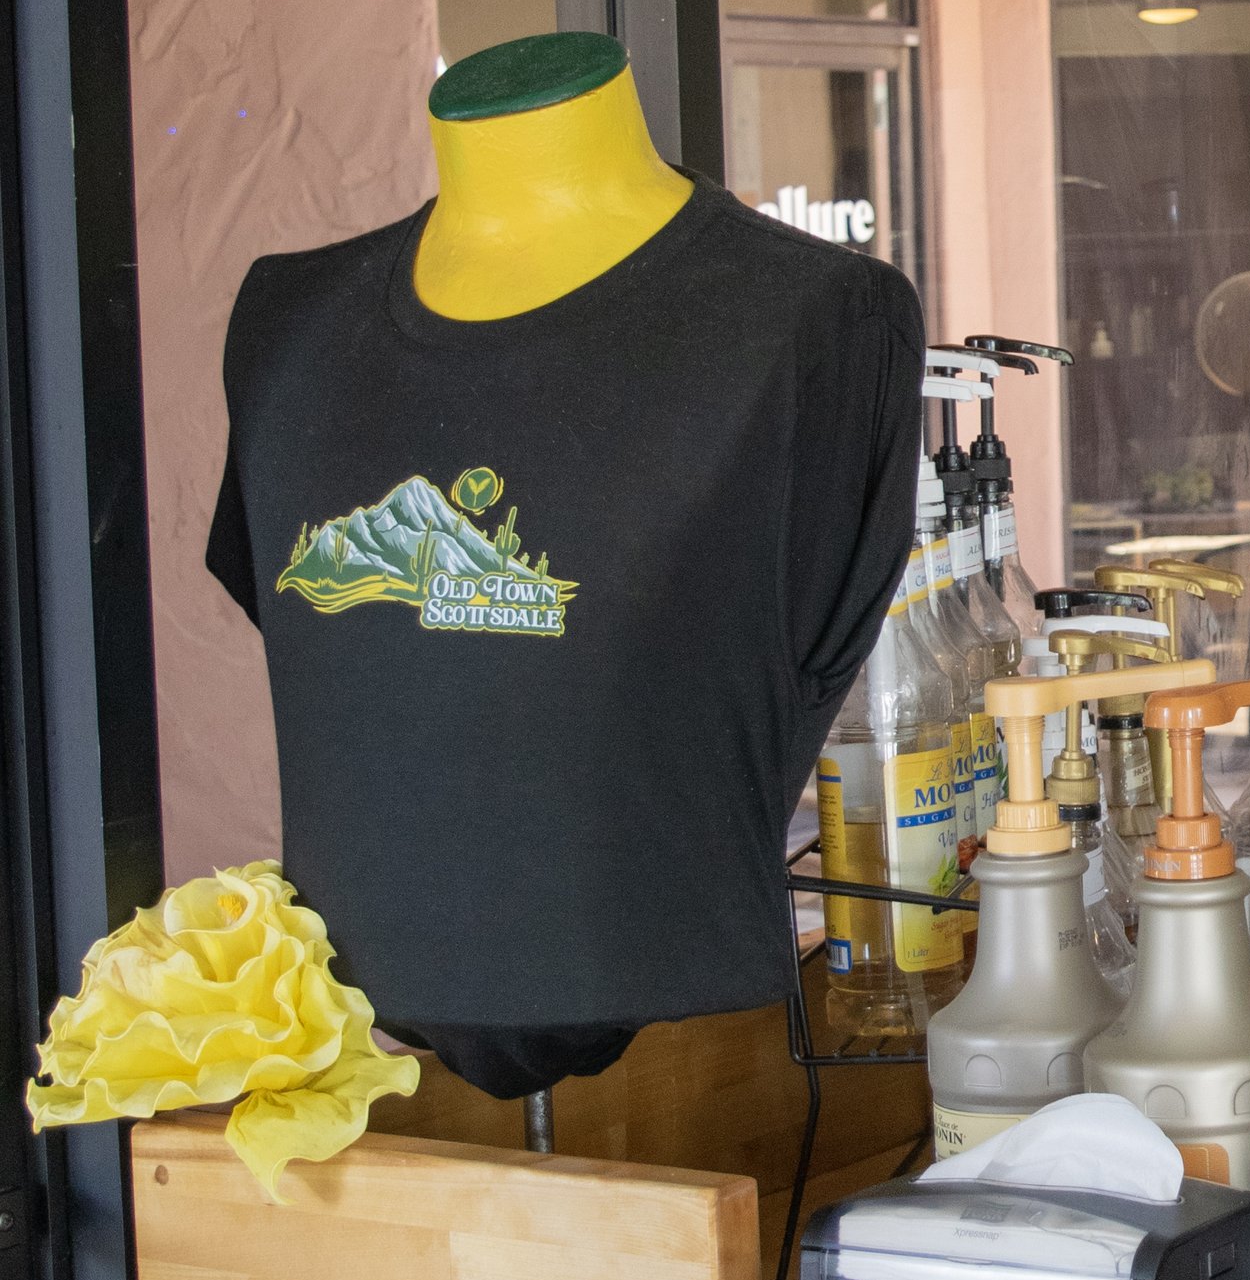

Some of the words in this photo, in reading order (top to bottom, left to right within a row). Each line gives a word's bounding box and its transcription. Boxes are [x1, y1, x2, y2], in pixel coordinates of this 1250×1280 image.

[432, 574, 476, 601] OLD
[483, 575, 558, 604] TOWN
[426, 600, 562, 630] SCOTTSDALE
